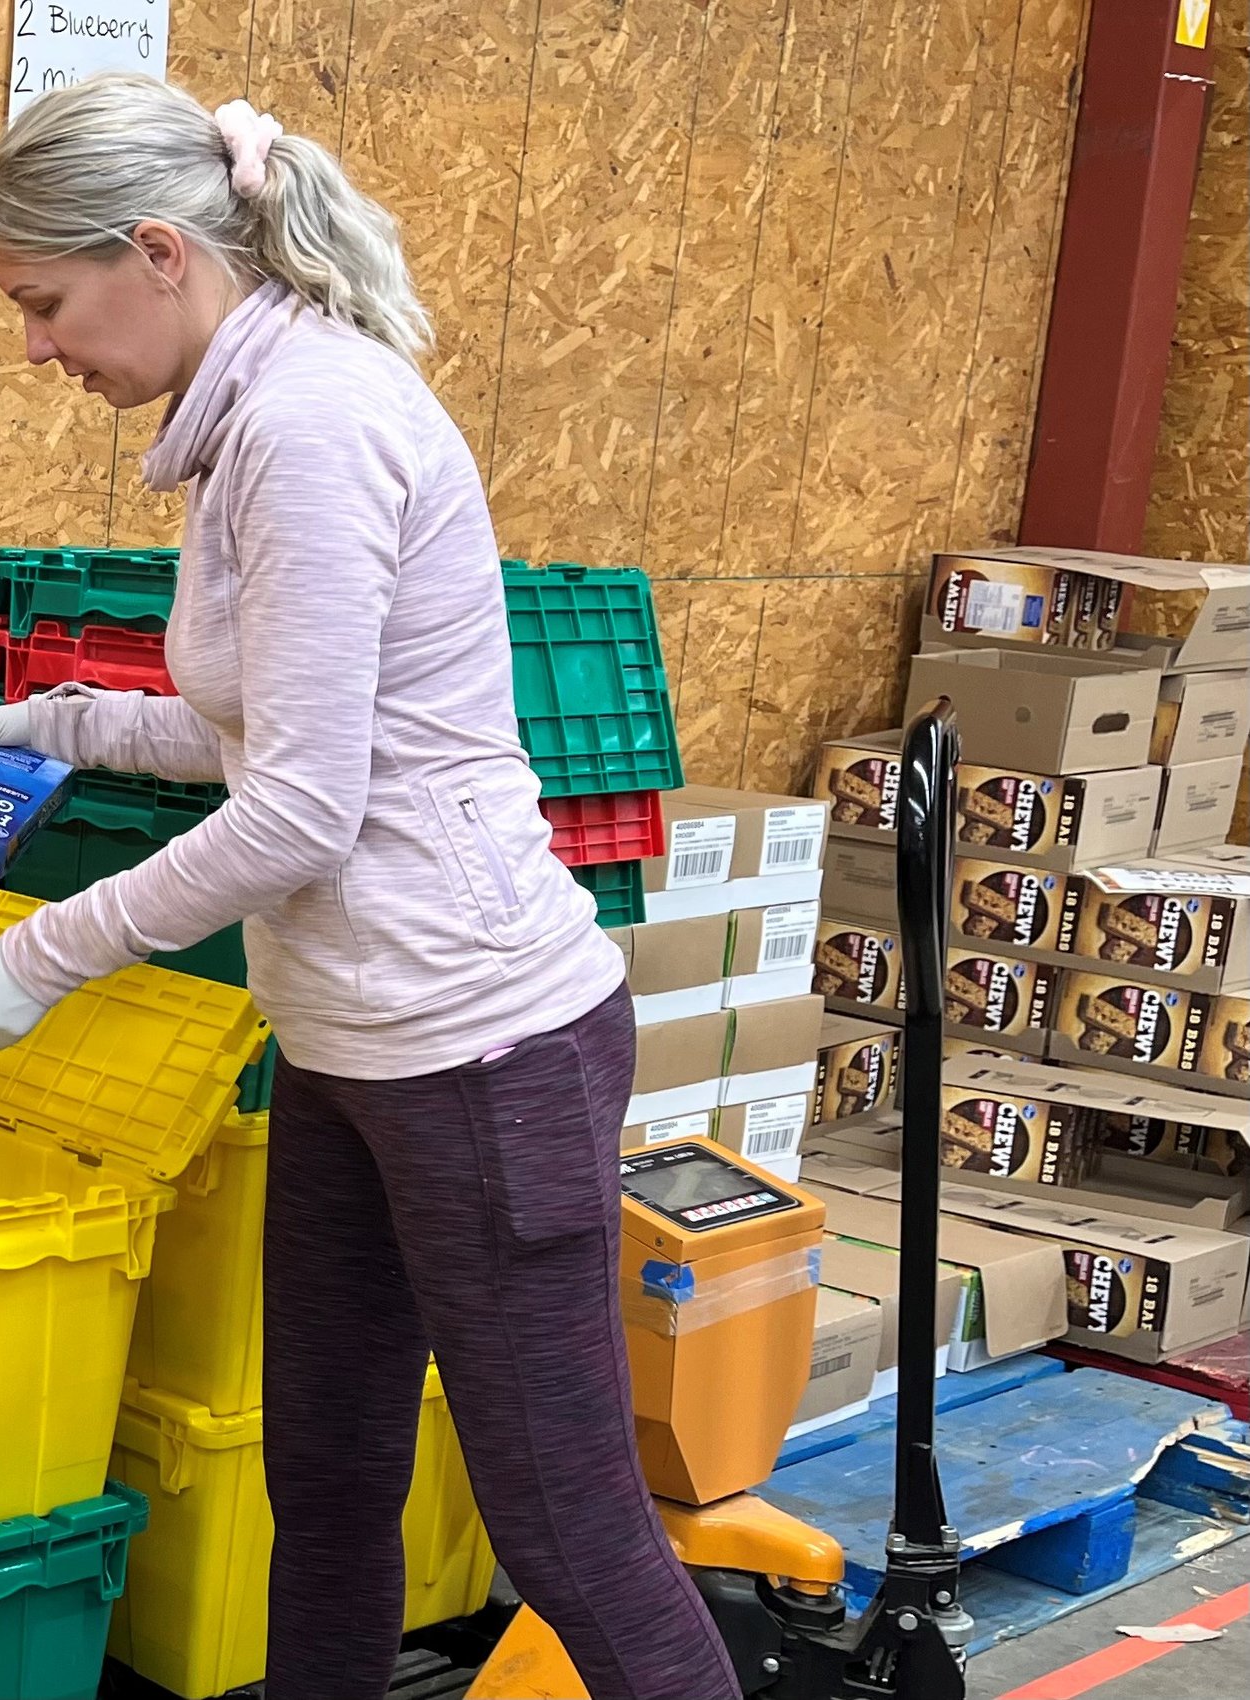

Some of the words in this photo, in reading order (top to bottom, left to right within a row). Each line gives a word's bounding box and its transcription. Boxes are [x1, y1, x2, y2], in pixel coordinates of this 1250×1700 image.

[17, 0, 37, 37] 2
[48, 5, 153, 58] Blueberry
[14, 56, 33, 93] 2
[942, 570, 963, 632] CHEWY
[1105, 578, 1119, 620] HEWY
[878, 761, 902, 830] CHEWY
[1009, 779, 1037, 851] CHEWY
[1062, 794, 1076, 811] 10
[1056, 815, 1073, 846] BAR
[1012, 874, 1040, 946] CHEWY
[1065, 890, 1079, 907] 10
[1058, 911, 1076, 952] BARS
[1153, 897, 1182, 971] CHEWY
[1210, 913, 1224, 930] 10
[856, 936, 880, 1003] CHEWY
[1204, 934, 1220, 967] BAR
[983, 962, 1010, 1032] CHEWY
[1035, 979, 1048, 995] 10
[1030, 999, 1045, 1029] BAR
[1132, 990, 1161, 1062] CHEWY
[1189, 1007, 1202, 1024] 10
[1180, 1028, 1199, 1070] BARS
[863, 1043, 881, 1112] CHEWY
[989, 1102, 1018, 1178] CHEWY
[1048, 1120, 1062, 1137] 10
[1127, 1115, 1150, 1156] EWY
[1176, 1124, 1192, 1155] BAR
[1041, 1141, 1060, 1184] BARS
[1087, 1254, 1114, 1334] CHEWY
[1145, 1275, 1160, 1294] 10
[1140, 1298, 1156, 1332] BAR
